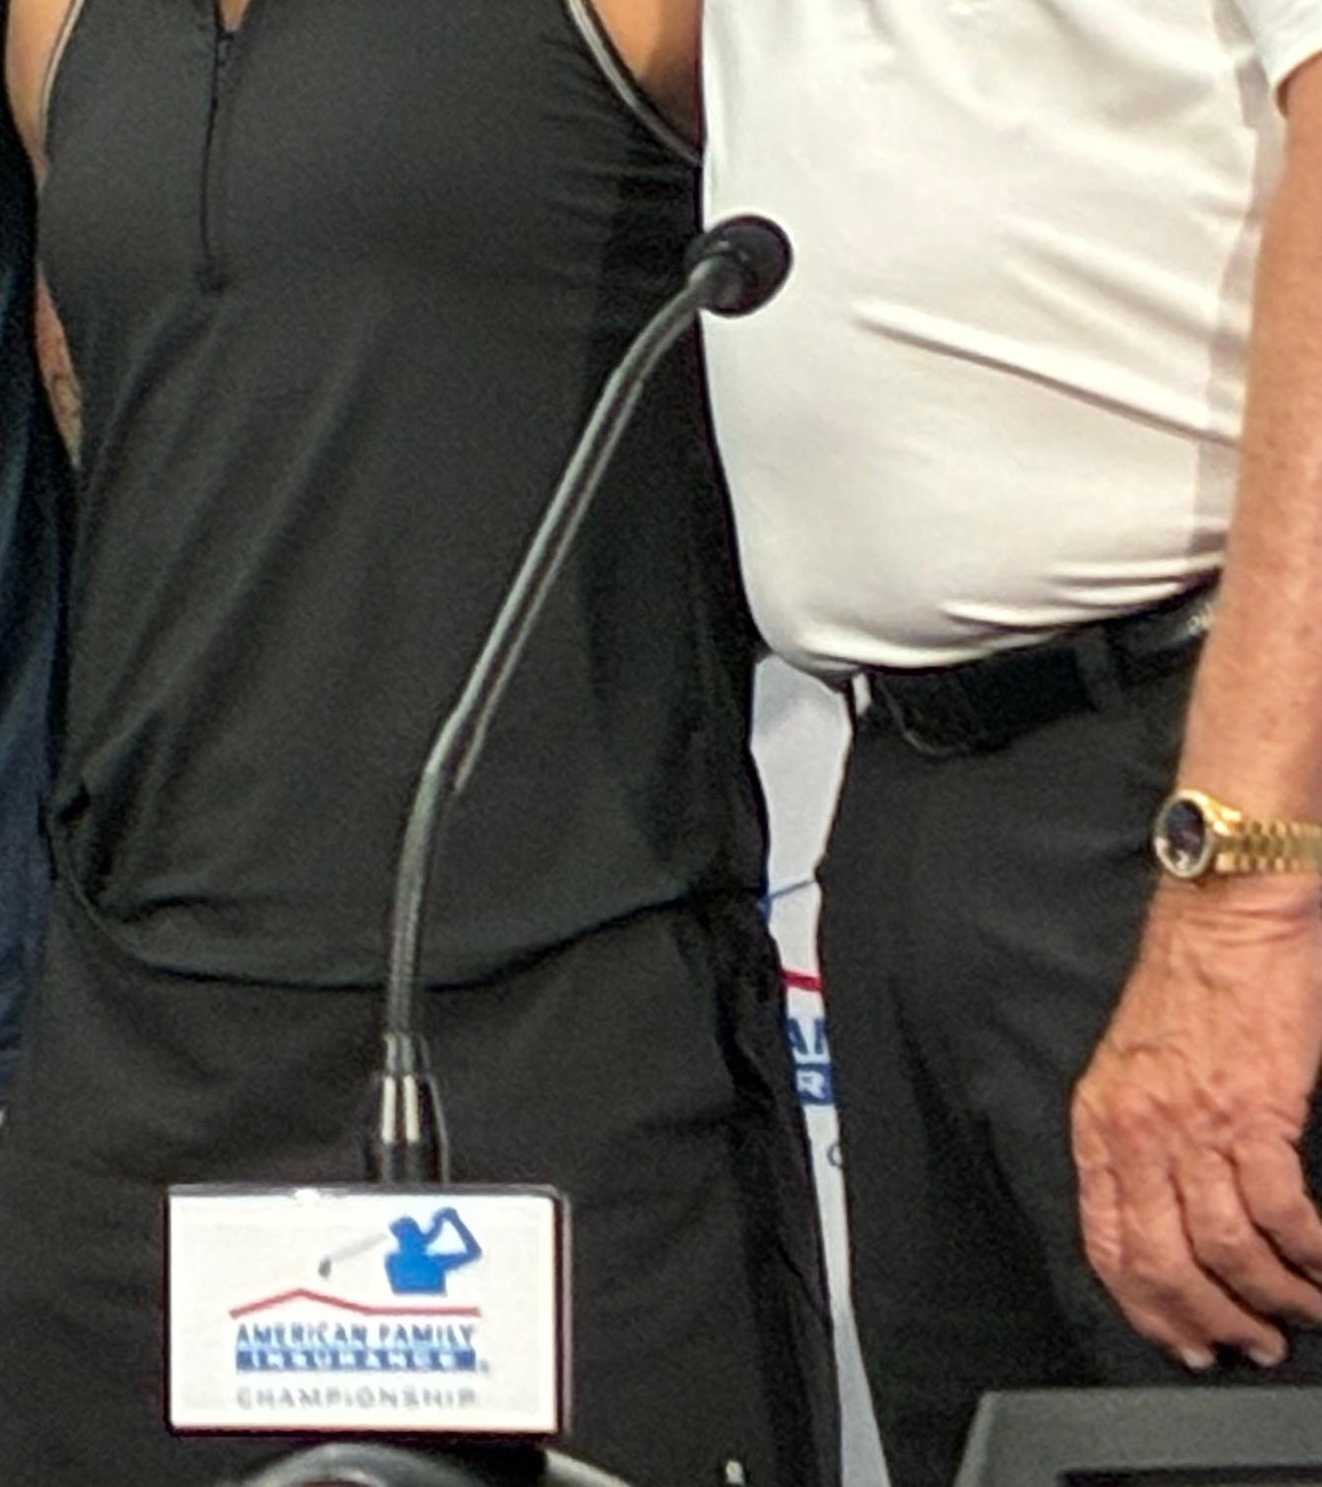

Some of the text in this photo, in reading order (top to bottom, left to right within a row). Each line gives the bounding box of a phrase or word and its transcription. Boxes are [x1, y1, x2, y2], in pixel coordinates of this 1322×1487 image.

[235, 1322, 475, 1348] AMERICAN FAMILY
[235, 1385, 477, 1410] CHAMPIONSHIP
